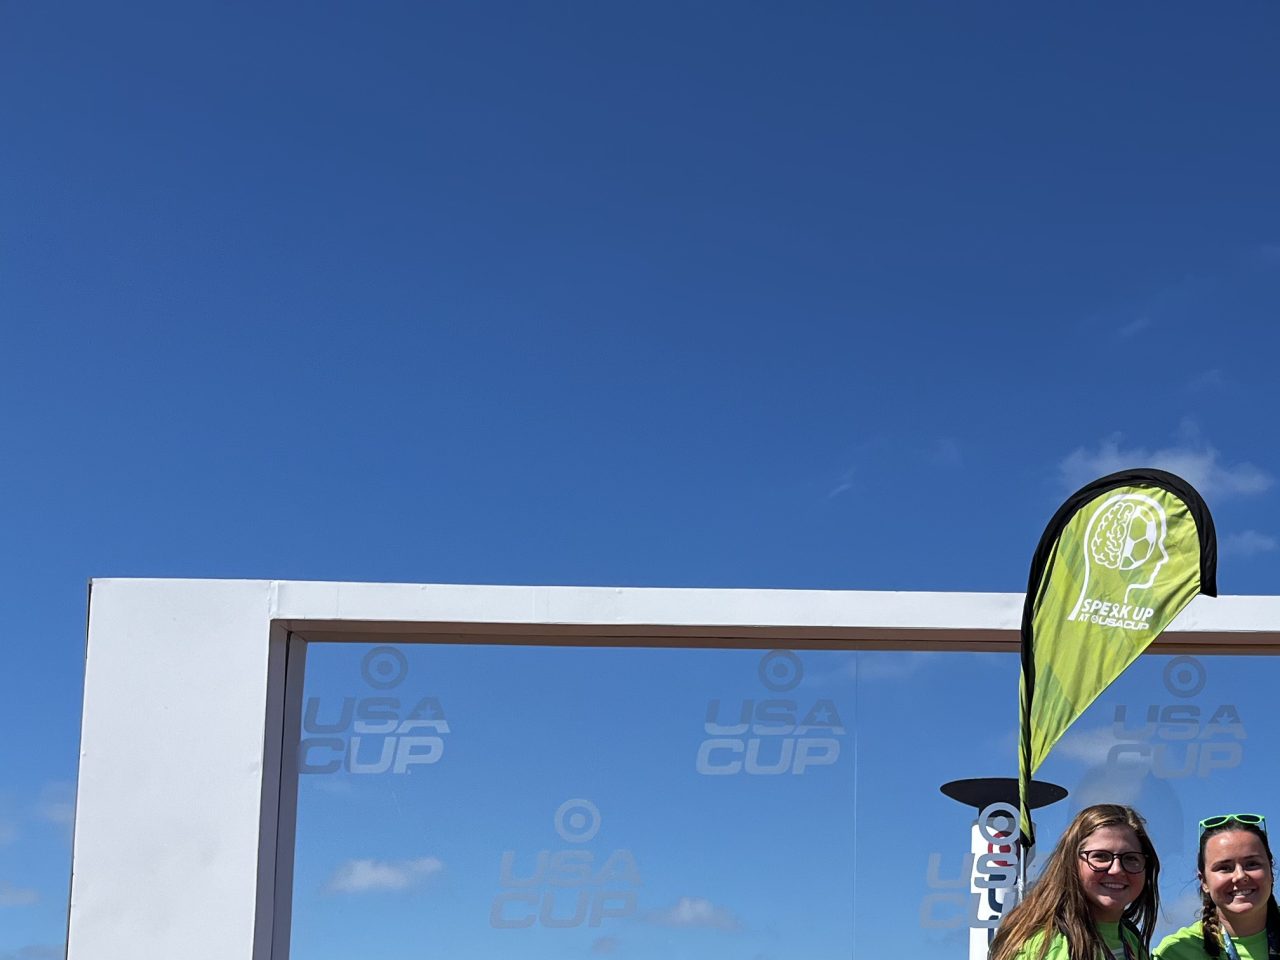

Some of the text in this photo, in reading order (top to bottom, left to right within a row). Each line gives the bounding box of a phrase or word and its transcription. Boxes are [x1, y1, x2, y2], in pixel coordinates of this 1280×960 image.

[1079, 613, 1091, 622] AT
[1132, 606, 1154, 622] UP
[303, 696, 450, 734] USA
[705, 699, 845, 735] USA
[1112, 705, 1246, 739] USA
[297, 736, 444, 774] CUP
[696, 738, 840, 775] CUP
[1107, 743, 1243, 778] CUP
[501, 850, 642, 888] USA
[489, 892, 637, 929] CUP
[919, 892, 1020, 928] CU
